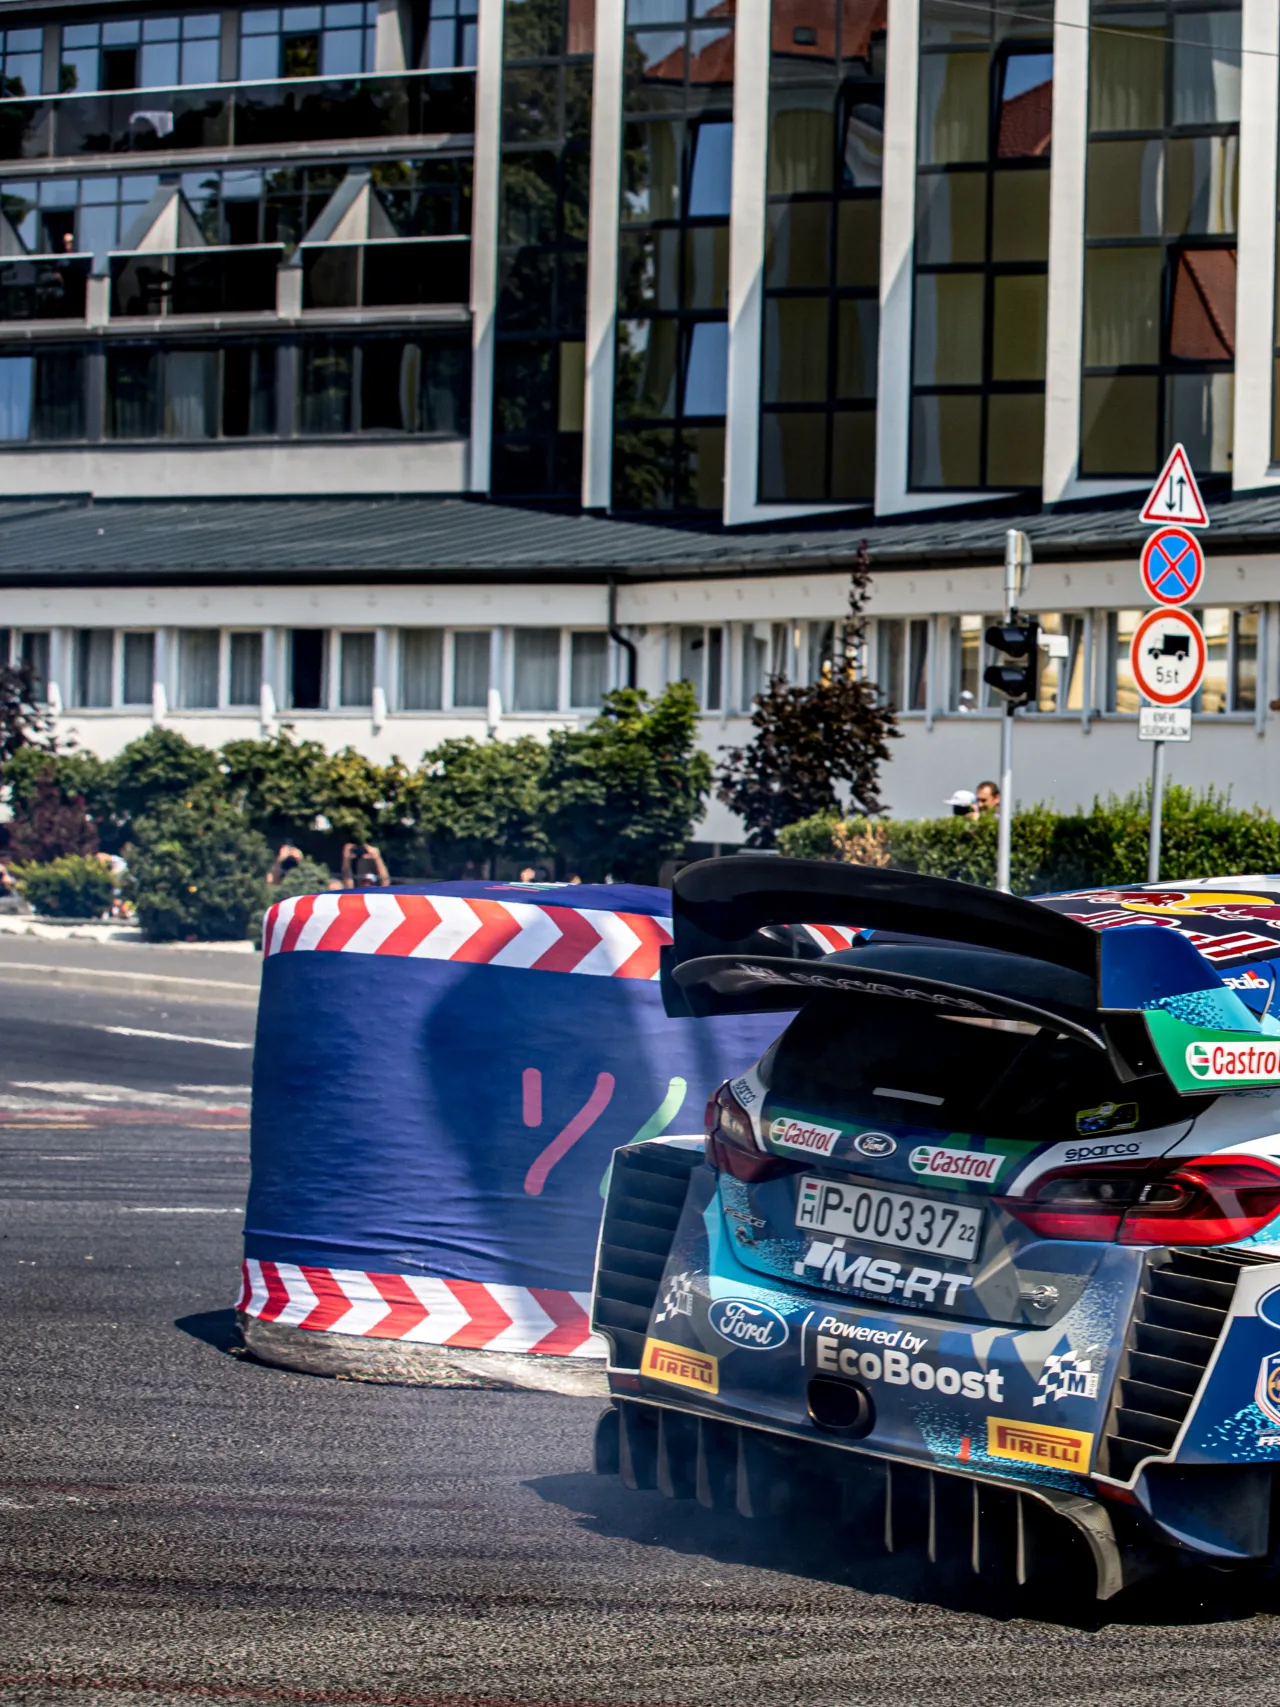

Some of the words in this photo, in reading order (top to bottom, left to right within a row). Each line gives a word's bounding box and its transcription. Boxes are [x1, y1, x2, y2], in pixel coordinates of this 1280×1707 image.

[783, 1122, 835, 1152] Castrol
[1065, 1142, 1141, 1162] sparco
[929, 1150, 999, 1179] Castrol
[801, 1203, 816, 1223] H
[821, 1186, 960, 1249] P-00337
[958, 1223, 977, 1243] 22
[823, 1250, 974, 1306] MS-RT
[719, 1302, 775, 1345] Ford
[817, 1315, 903, 1347] Powered
[900, 1331, 929, 1355] by
[649, 1346, 714, 1385] PIRELLI
[816, 1334, 1005, 1403] EcoBoost
[1068, 1373, 1088, 1395] M
[997, 1425, 1083, 1464] PIRELLI
